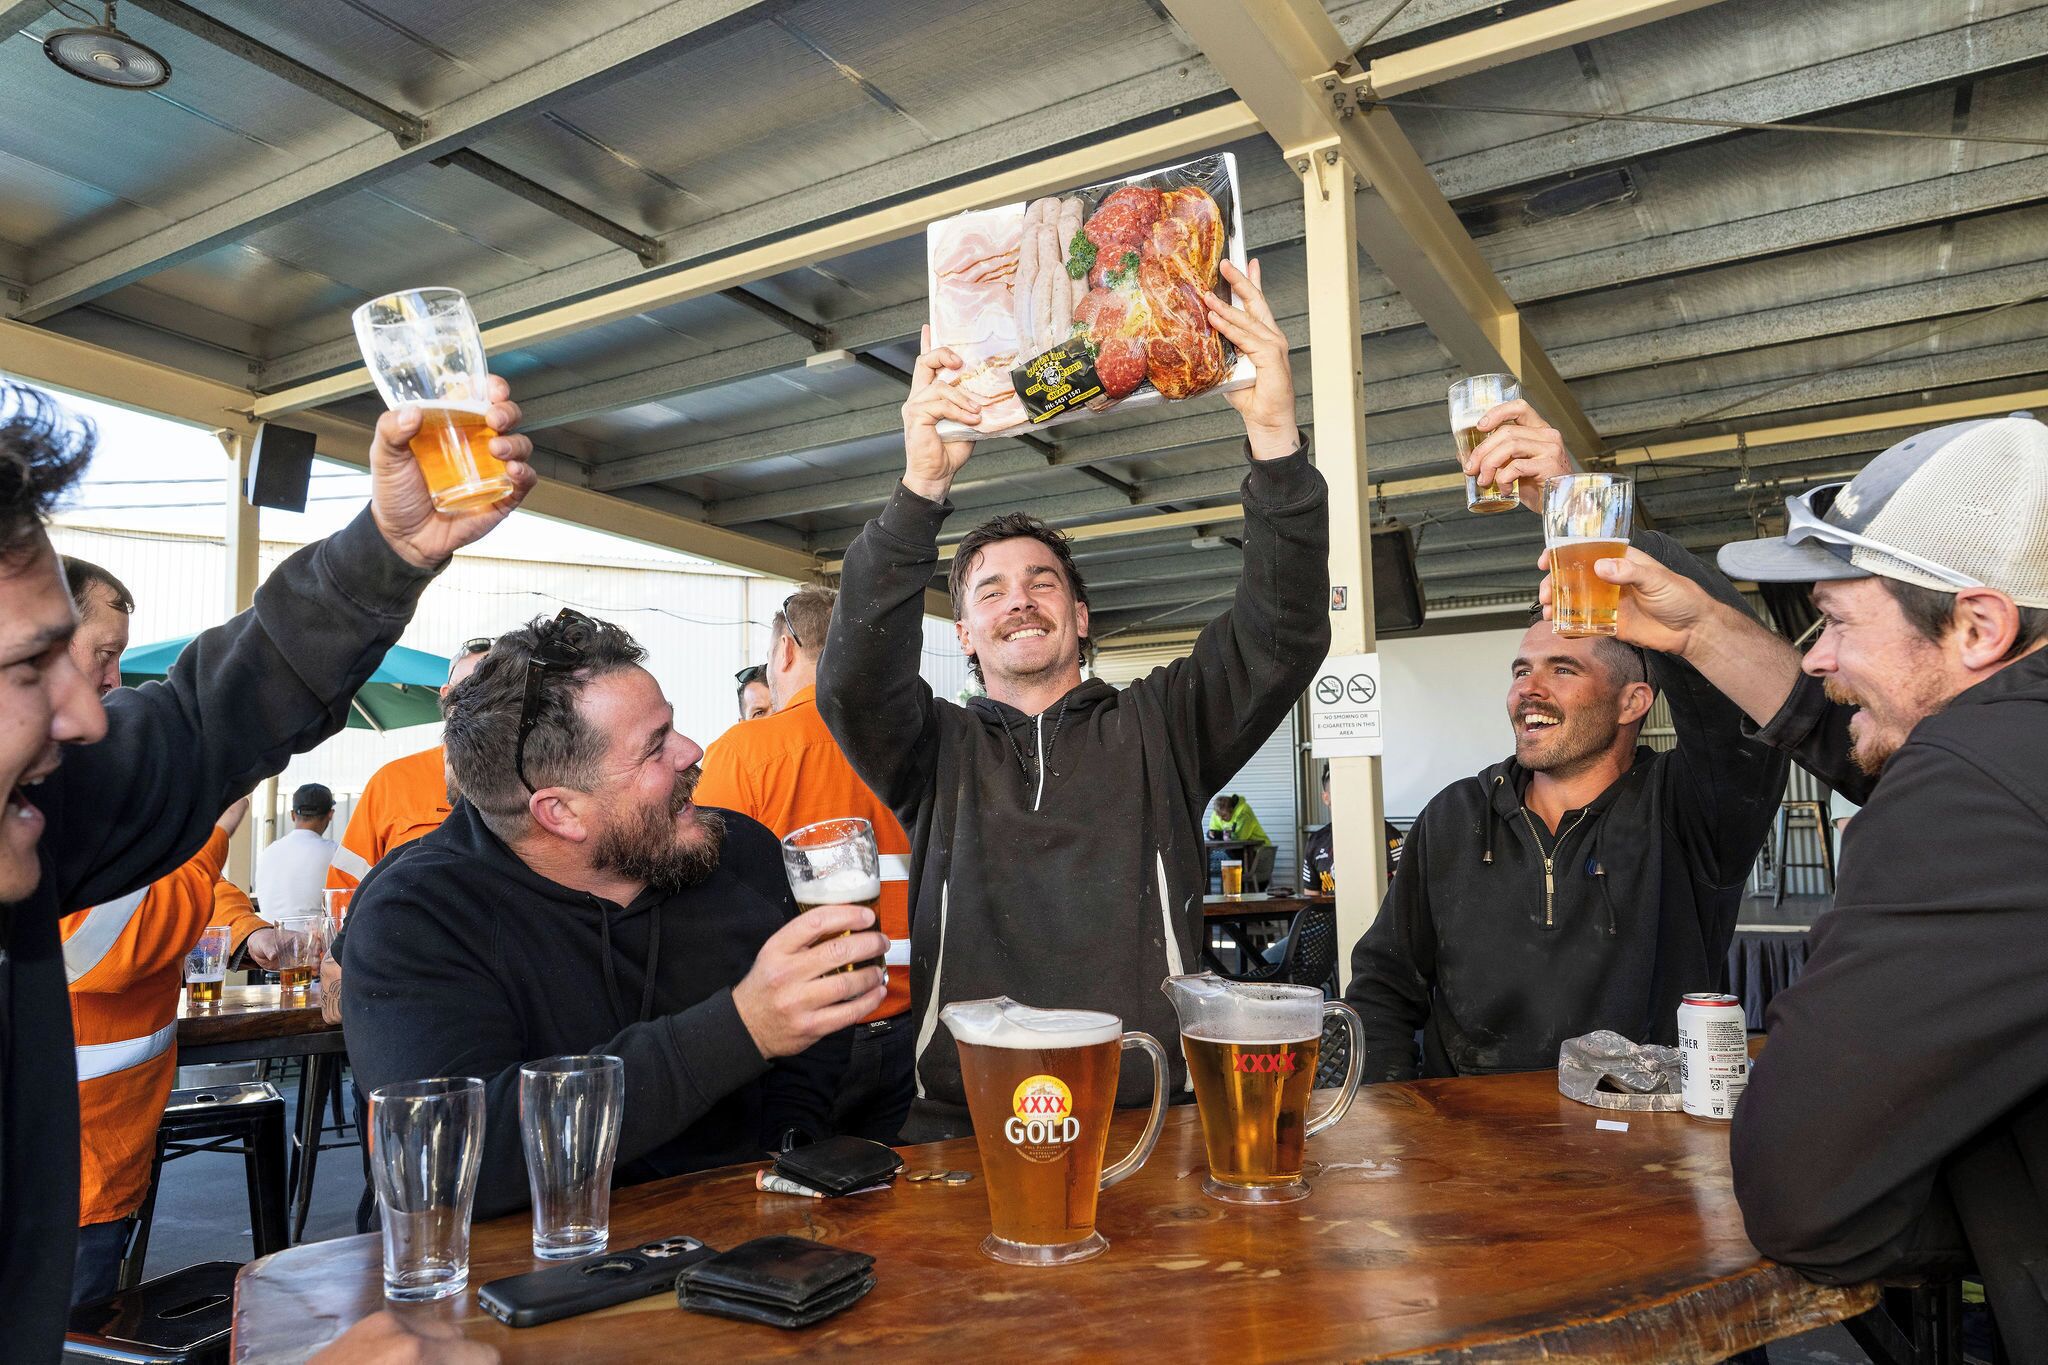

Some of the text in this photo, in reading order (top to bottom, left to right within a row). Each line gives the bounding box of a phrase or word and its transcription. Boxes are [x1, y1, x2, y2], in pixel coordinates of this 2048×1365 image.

[1049, 385, 1070, 399] MEATS
[1233, 1052, 1297, 1073] XXXX
[1017, 1096, 1068, 1113] XXXX
[1004, 1116, 1081, 1145] GOLD
